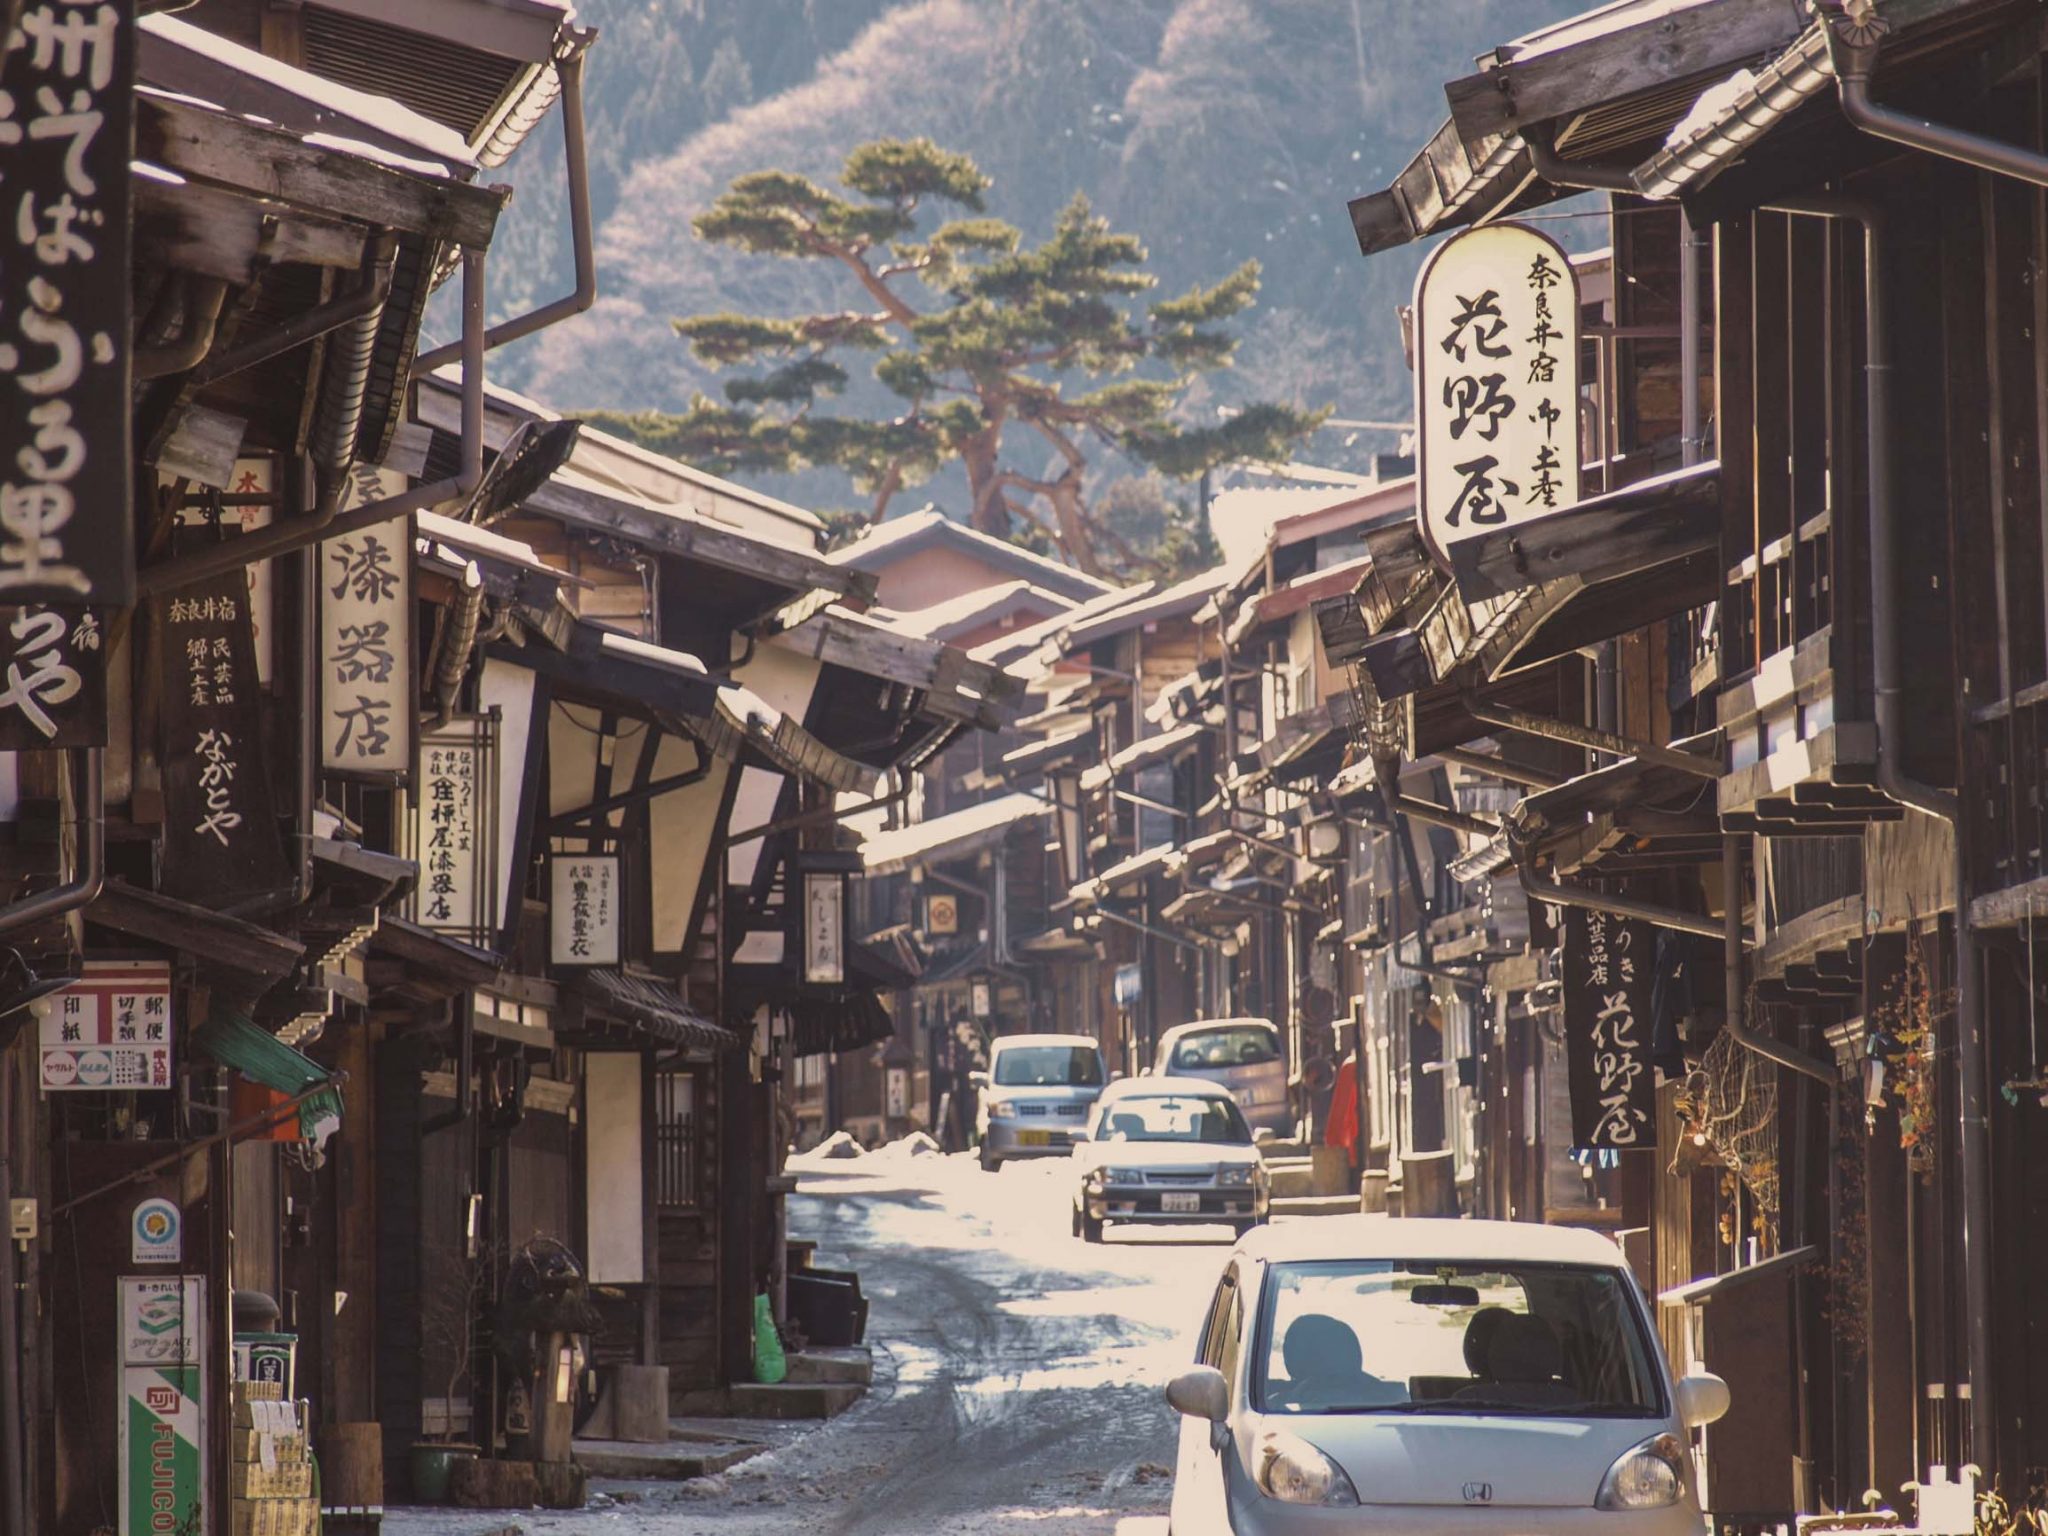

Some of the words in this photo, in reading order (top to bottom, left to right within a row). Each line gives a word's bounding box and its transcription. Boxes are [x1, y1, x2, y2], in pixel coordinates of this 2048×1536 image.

[0, 0, 119, 594] 州そばふる里
[1526, 253, 1563, 385] 奈良井宿
[1440, 289, 1519, 528] 花野屋
[169, 596, 236, 624] 奈良井宿
[186, 638, 210, 706] 郷土土産
[212, 637, 235, 705] 民芸品
[194, 728, 242, 847] ながとや
[1613, 912, 1635, 983] のき
[61, 996, 82, 1042] 印紙
[117, 996, 137, 1041] 切手類
[144, 996, 165, 1041] 郵便
[1590, 990, 1647, 1145] 花野屋
[150, 1423, 177, 1536] FUJICO
